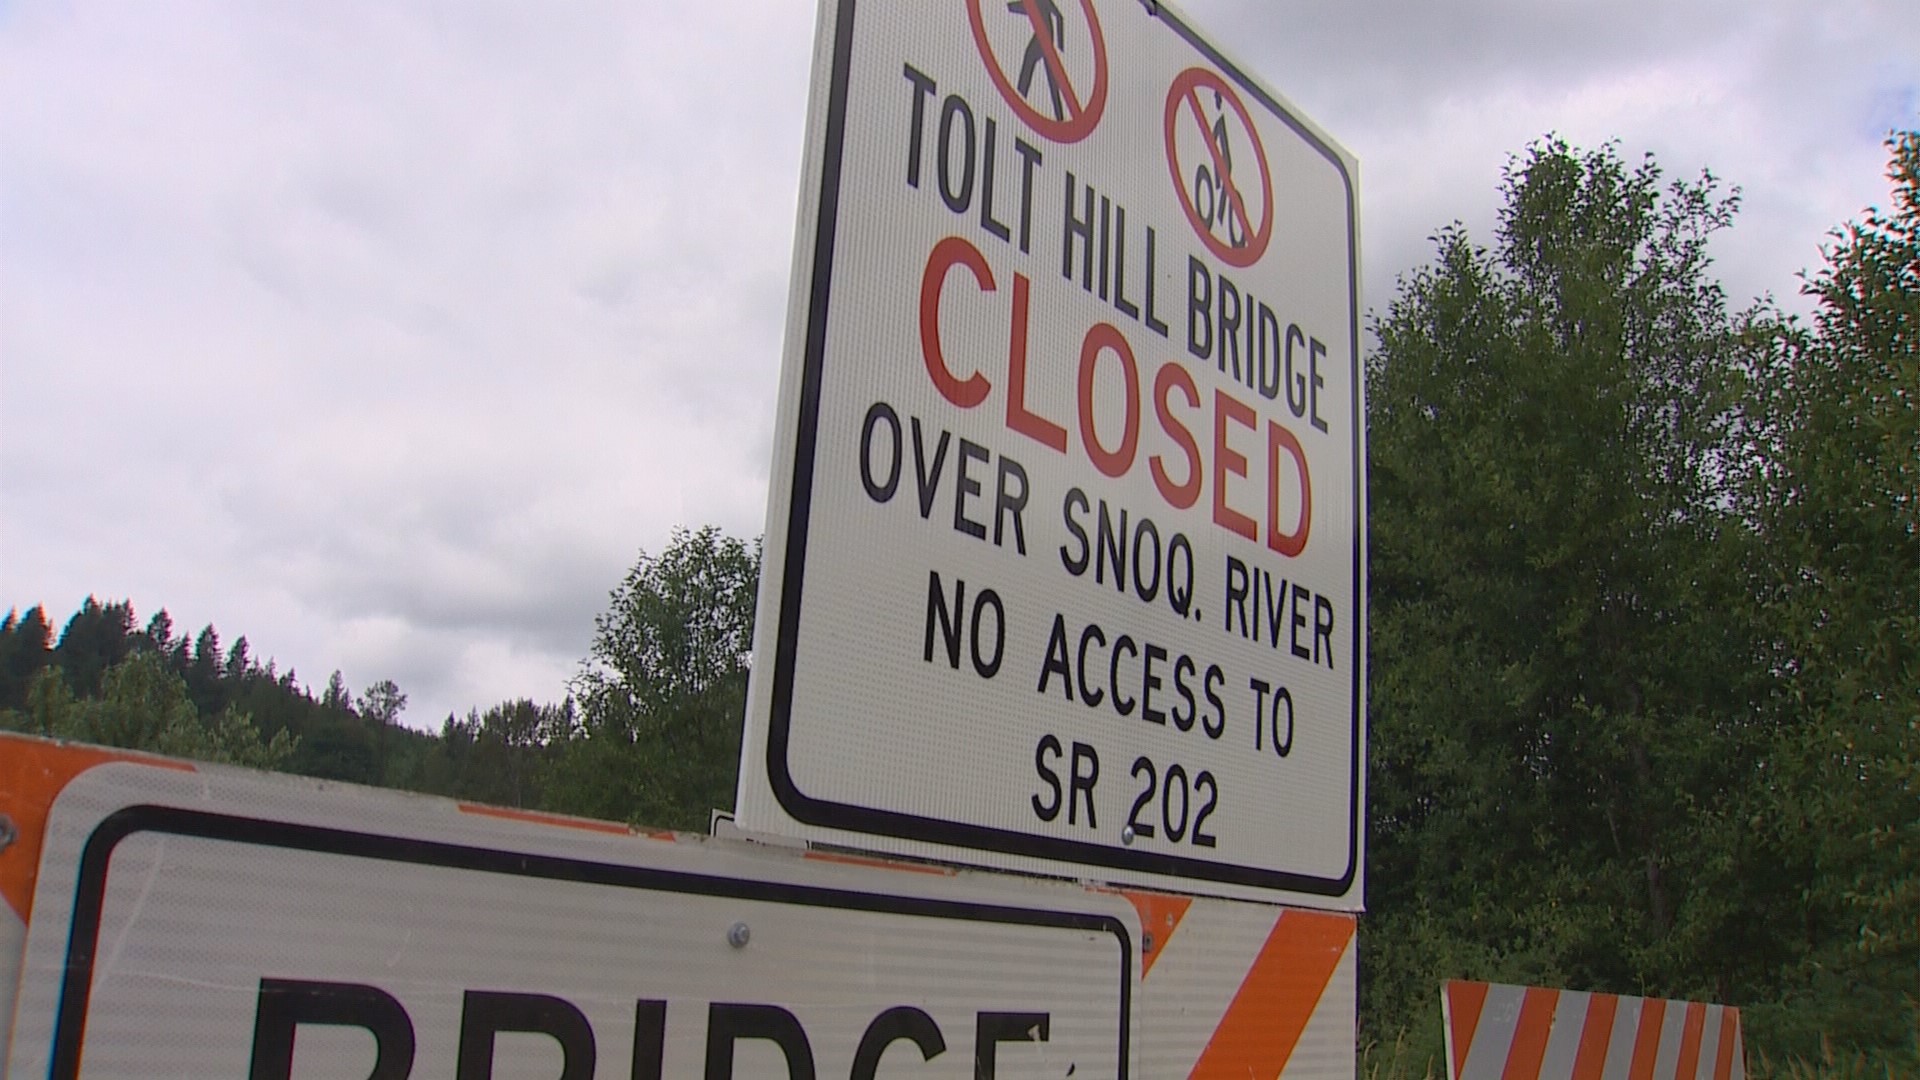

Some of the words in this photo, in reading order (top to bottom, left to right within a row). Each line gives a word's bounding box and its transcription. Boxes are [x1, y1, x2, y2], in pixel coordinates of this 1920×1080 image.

[903, 61, 1044, 256] TOLT
[1062, 170, 1169, 339] HILL
[1188, 254, 1329, 434] BRIDGE
[919, 236, 1312, 558] CLOSED
[860, 402, 1030, 556] OVER
[1059, 487, 1202, 622] SNOQ.
[1225, 555, 1335, 669] RIVER
[923, 571, 1006, 678] NO
[1036, 613, 1226, 740] ACCESS
[1249, 677, 1295, 758] TO
[1031, 734, 1099, 828] SR
[1128, 756, 1219, 848] 202
